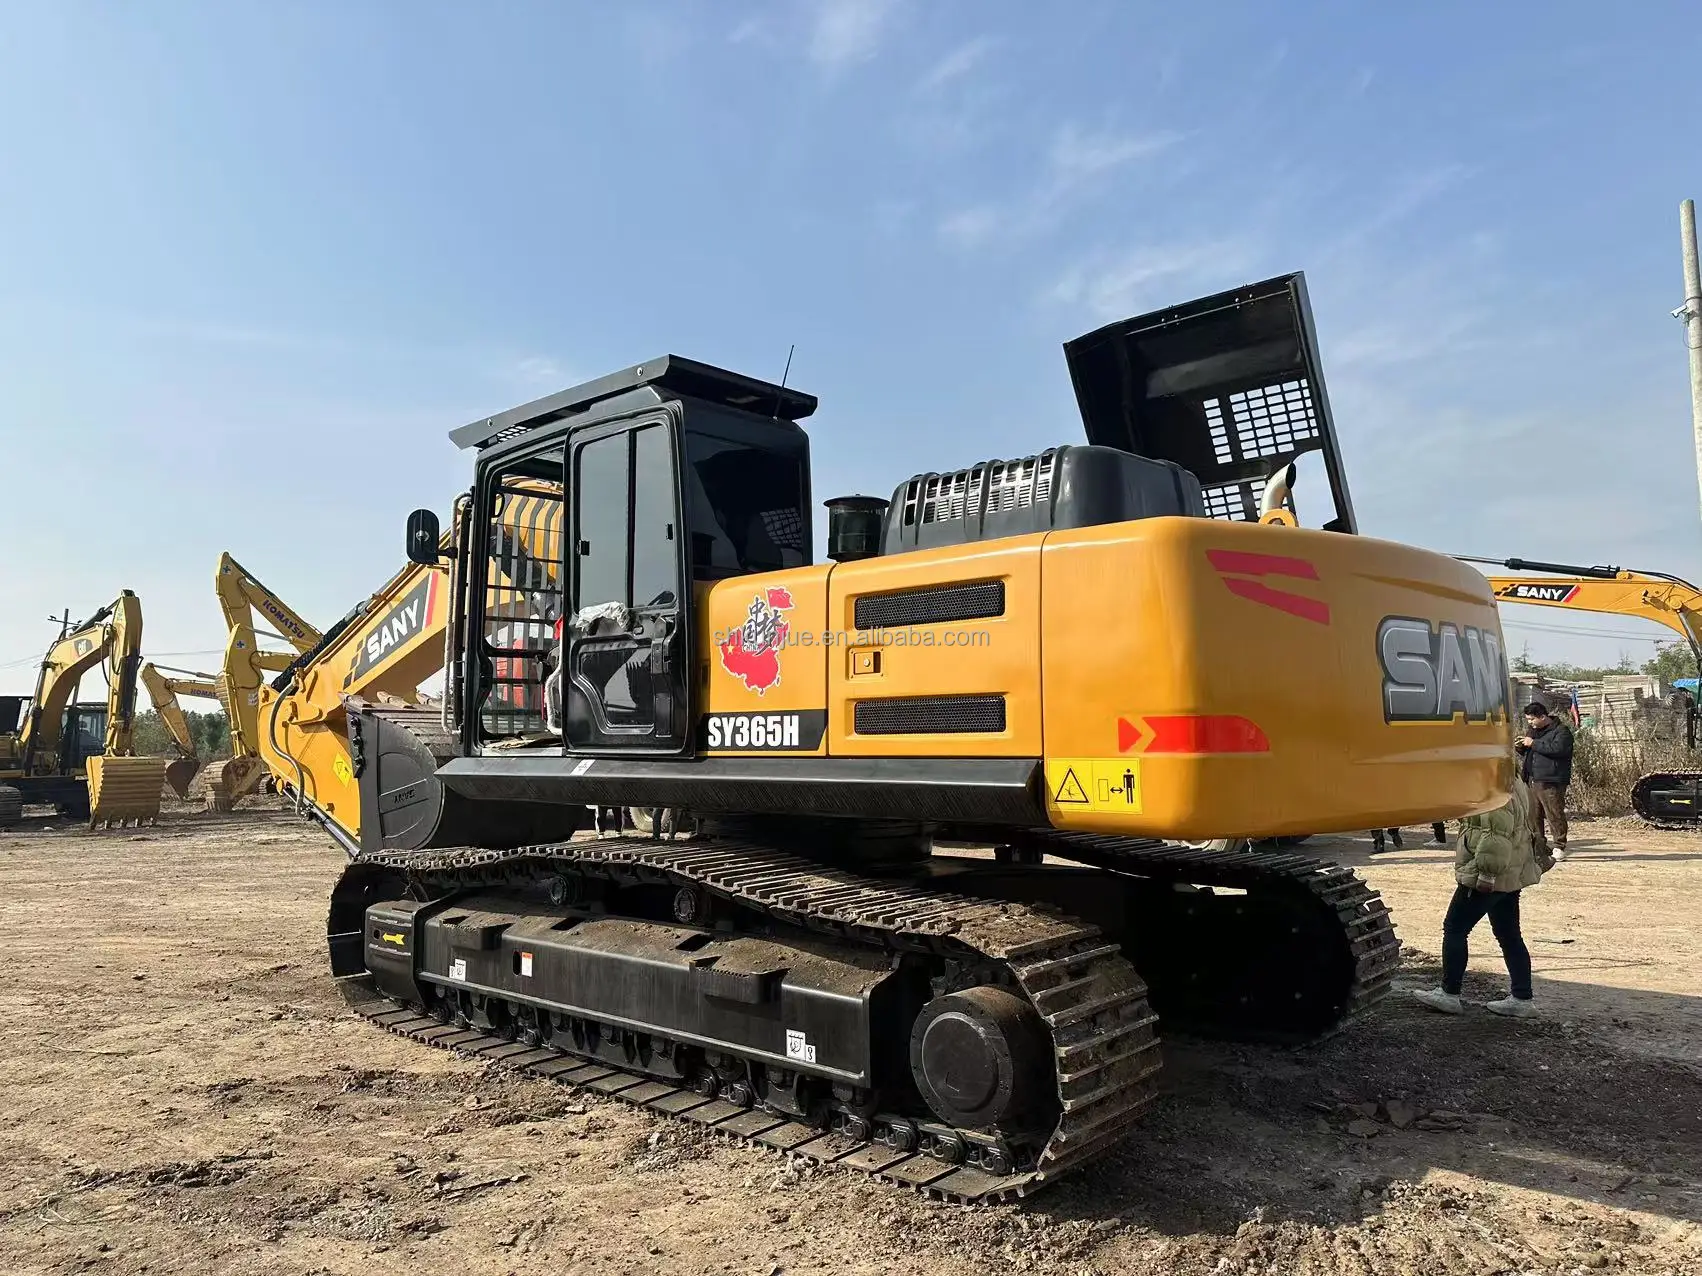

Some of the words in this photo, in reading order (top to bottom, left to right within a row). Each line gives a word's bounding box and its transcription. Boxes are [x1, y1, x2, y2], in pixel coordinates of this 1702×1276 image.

[1517, 586, 1563, 600] SANY
[262, 599, 305, 639] KOMATSU
[366, 598, 419, 664] SANY
[1377, 616, 1509, 722] SAN
[190, 688, 217, 698] KOMAT
[708, 715, 799, 747] SY365H
